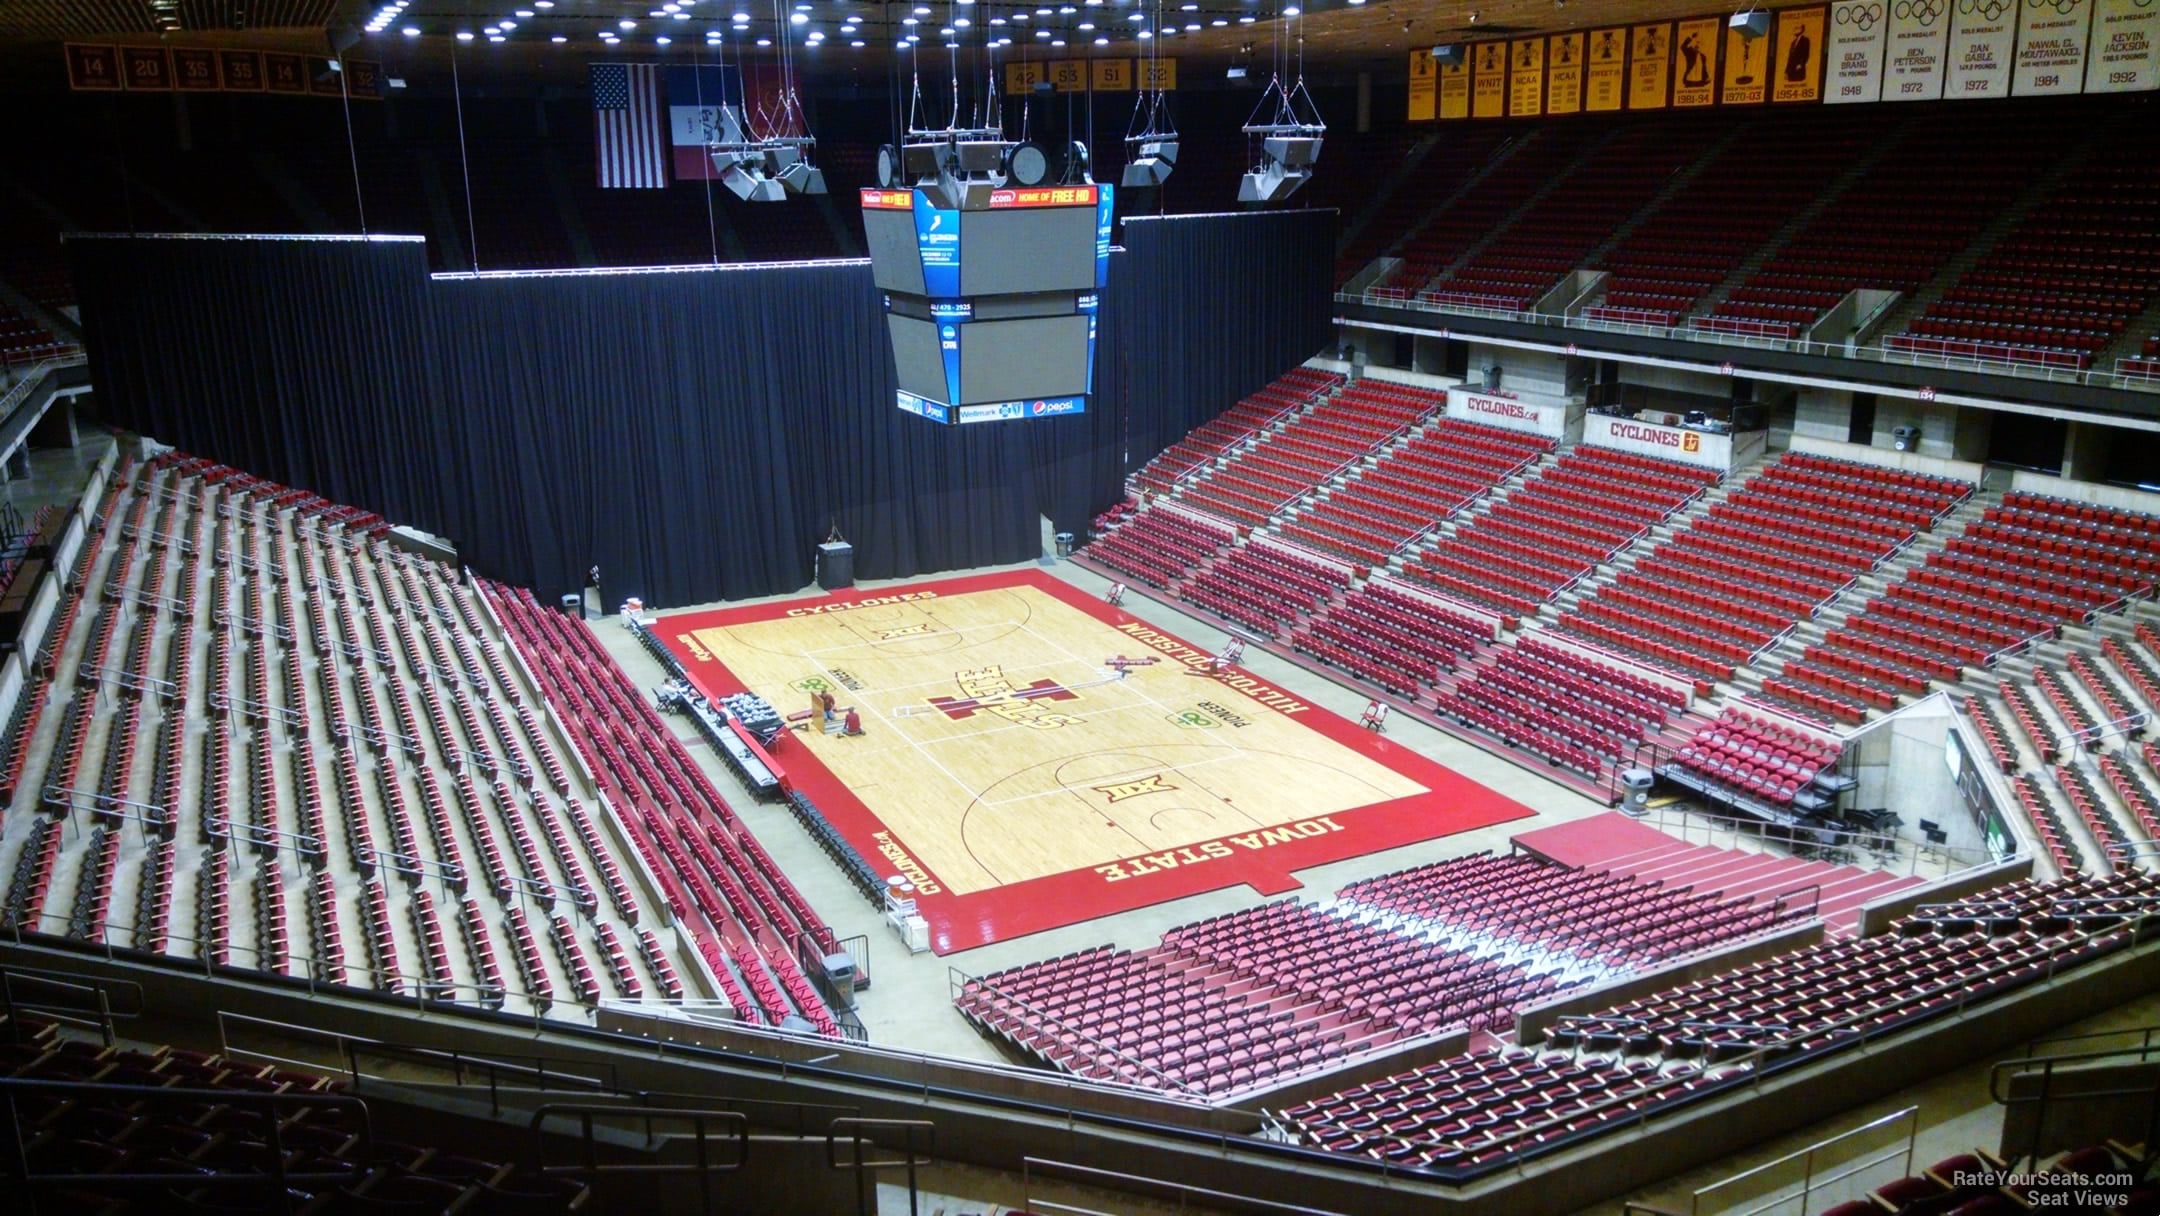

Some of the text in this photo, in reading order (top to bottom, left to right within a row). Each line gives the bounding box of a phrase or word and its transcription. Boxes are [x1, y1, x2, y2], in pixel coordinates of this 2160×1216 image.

[2112, 32, 2144, 42] KEVIN
[1970, 43, 1989, 53] DAN
[2028, 40, 2060, 49] NAWAL
[2104, 41, 2149, 52] JACKSON
[1893, 56, 1936, 66] PETERSON
[1965, 52, 1993, 62] GABLE
[83, 57, 104, 76] 14
[134, 59, 159, 77] 20
[1841, 60, 1867, 69] BRAND
[276, 63, 294, 81] 14
[1554, 71, 1577, 82] NCAA
[2109, 71, 2137, 83] 1992
[1015, 72, 1035, 85] 42
[1477, 77, 1502, 88] WNIT
[1515, 75, 1537, 85] NCAA
[2034, 75, 2059, 87] 1984
[1841, 85, 1861, 96] 1948
[1901, 82, 1922, 93] 1972
[1964, 80, 1988, 91] 1972
[1776, 89, 1814, 100] 1954-85
[1018, 193, 1040, 202] HOME
[1040, 192, 1051, 201] OF
[1051, 190, 1075, 203] FREE
[1075, 189, 1090, 203] HD
[960, 400, 1073, 421] Wellmark pepsi
[1610, 422, 1681, 447] CYCLONES
[786, 591, 937, 617] CYCLONES
[1197, 701, 1251, 728] PIONEER
[1094, 816, 1345, 883] IOWA STATE
